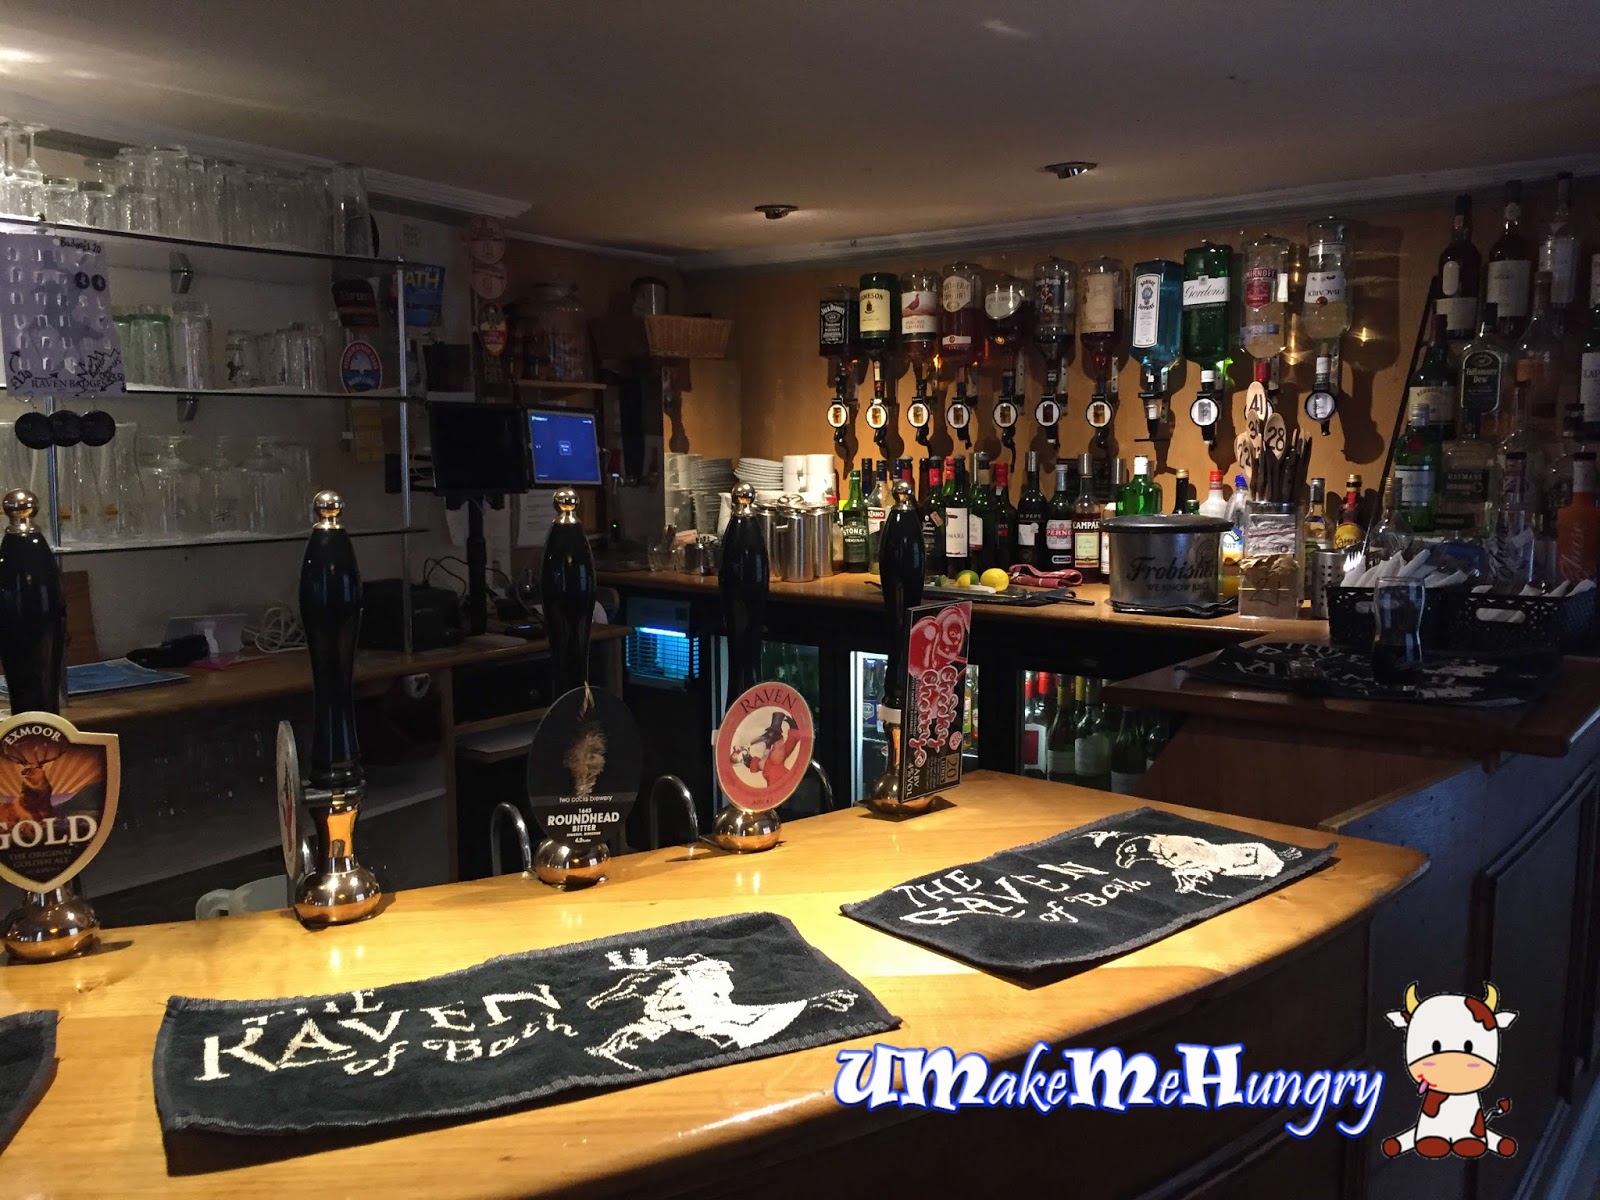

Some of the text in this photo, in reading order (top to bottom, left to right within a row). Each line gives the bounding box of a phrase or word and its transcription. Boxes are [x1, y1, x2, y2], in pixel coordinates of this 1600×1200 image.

[861, 292, 884, 301] AMESON
[1185, 285, 1226, 299] Gordon's
[31, 379, 68, 388] RAVEN
[1249, 393, 1263, 415] 41
[1267, 426, 1285, 452] 28
[1047, 529, 1072, 537] PERNO
[740, 688, 797, 714] RAVEN
[5, 725, 62, 746] EXMOOR
[913, 768, 921, 788] ABV
[945, 758, 958, 779] 20
[547, 812, 621, 826] ROUNDHEAD
[572, 824, 597, 832] BITTER
[892, 869, 983, 908] THE
[899, 861, 1109, 926] RAVEN
[1039, 901, 1079, 924] of
[241, 989, 384, 1026] TE
[343, 1040, 410, 1077] of
